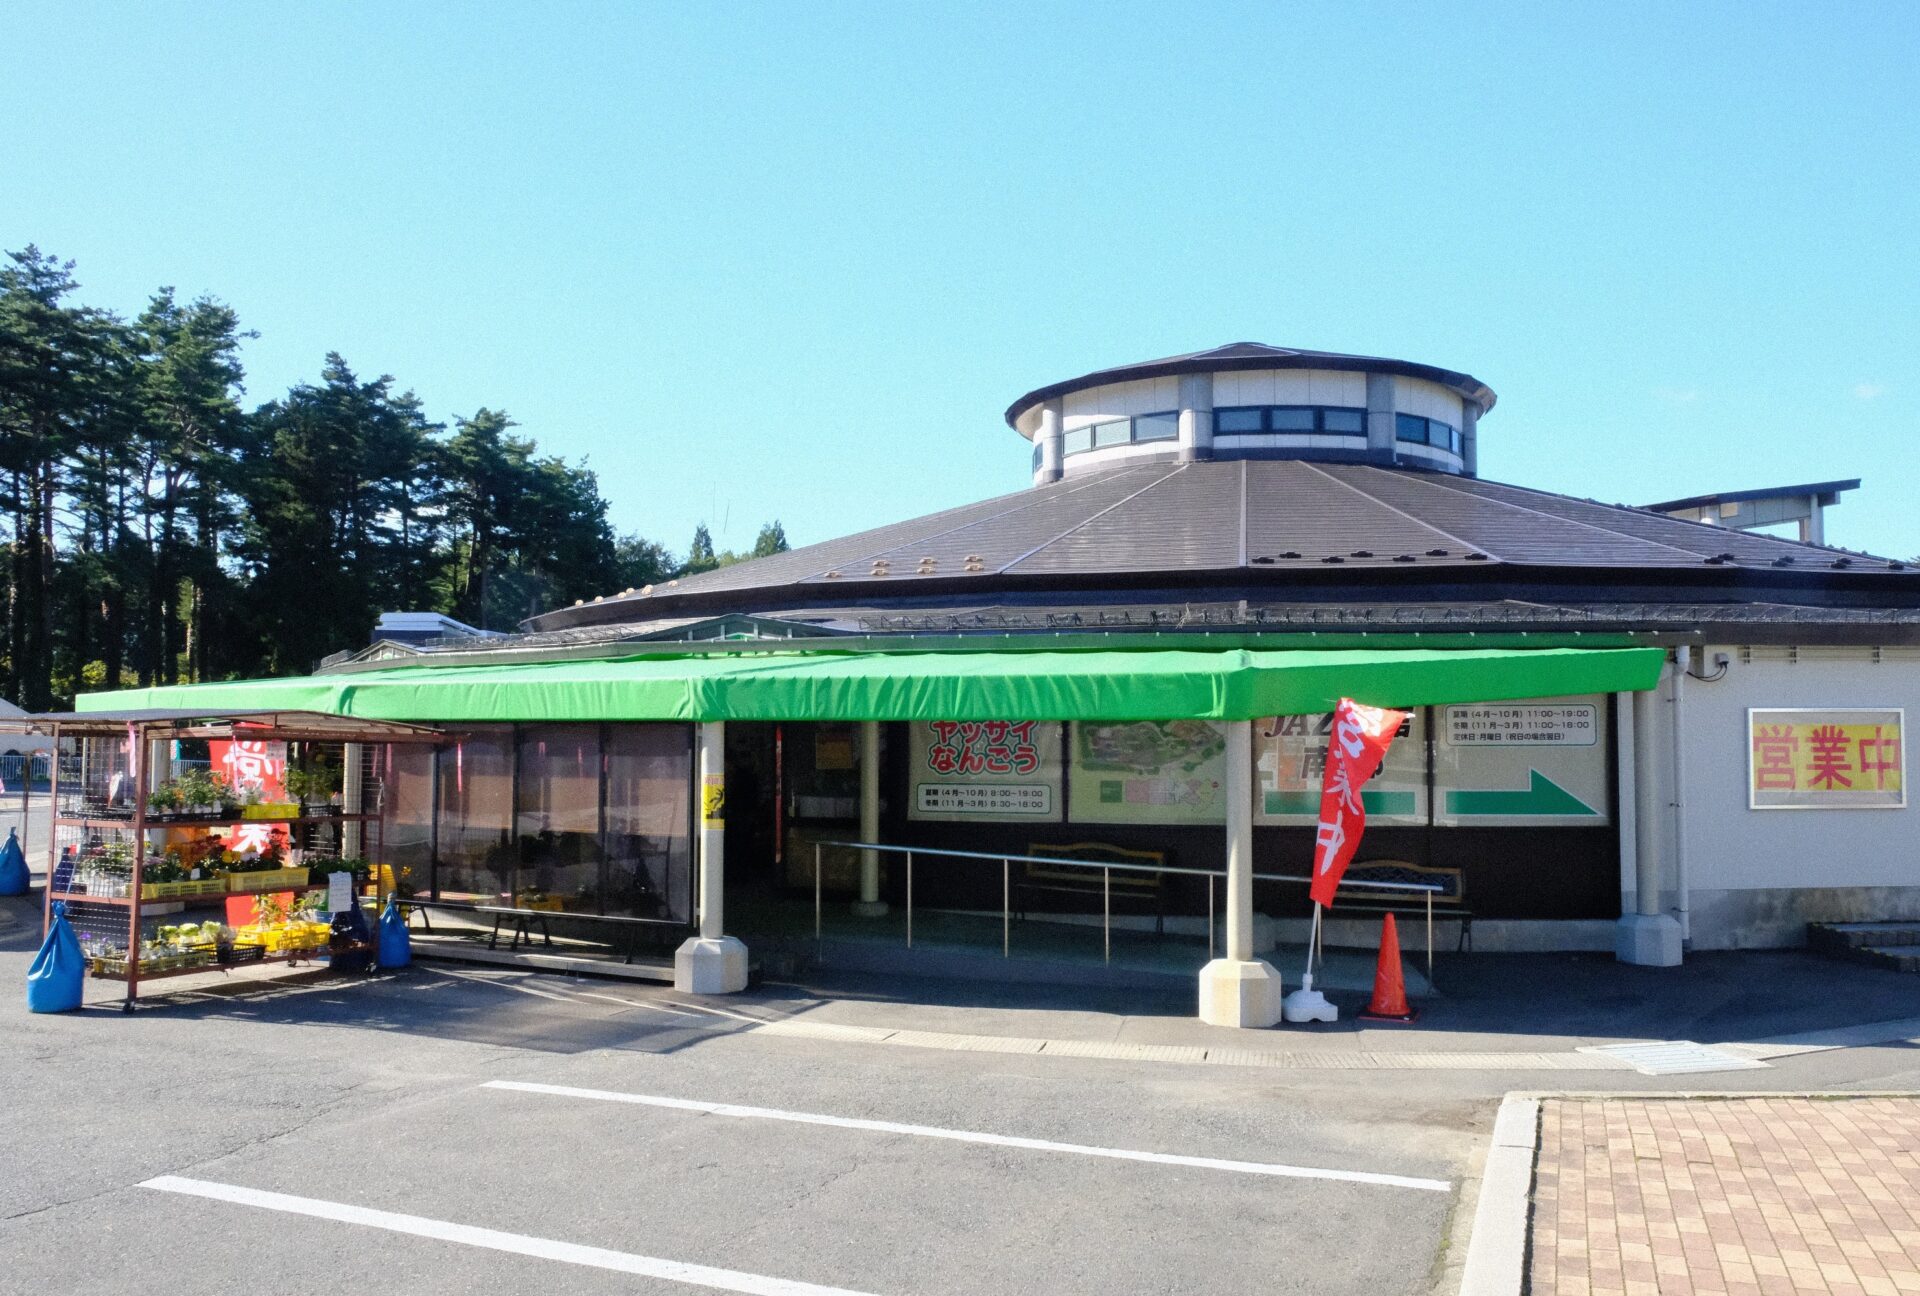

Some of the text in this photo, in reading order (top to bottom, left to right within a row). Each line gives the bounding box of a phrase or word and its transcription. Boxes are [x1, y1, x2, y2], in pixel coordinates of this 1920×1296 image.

[931, 745, 1039, 773] なんごう
[1753, 725, 1901, 790] 営業中
